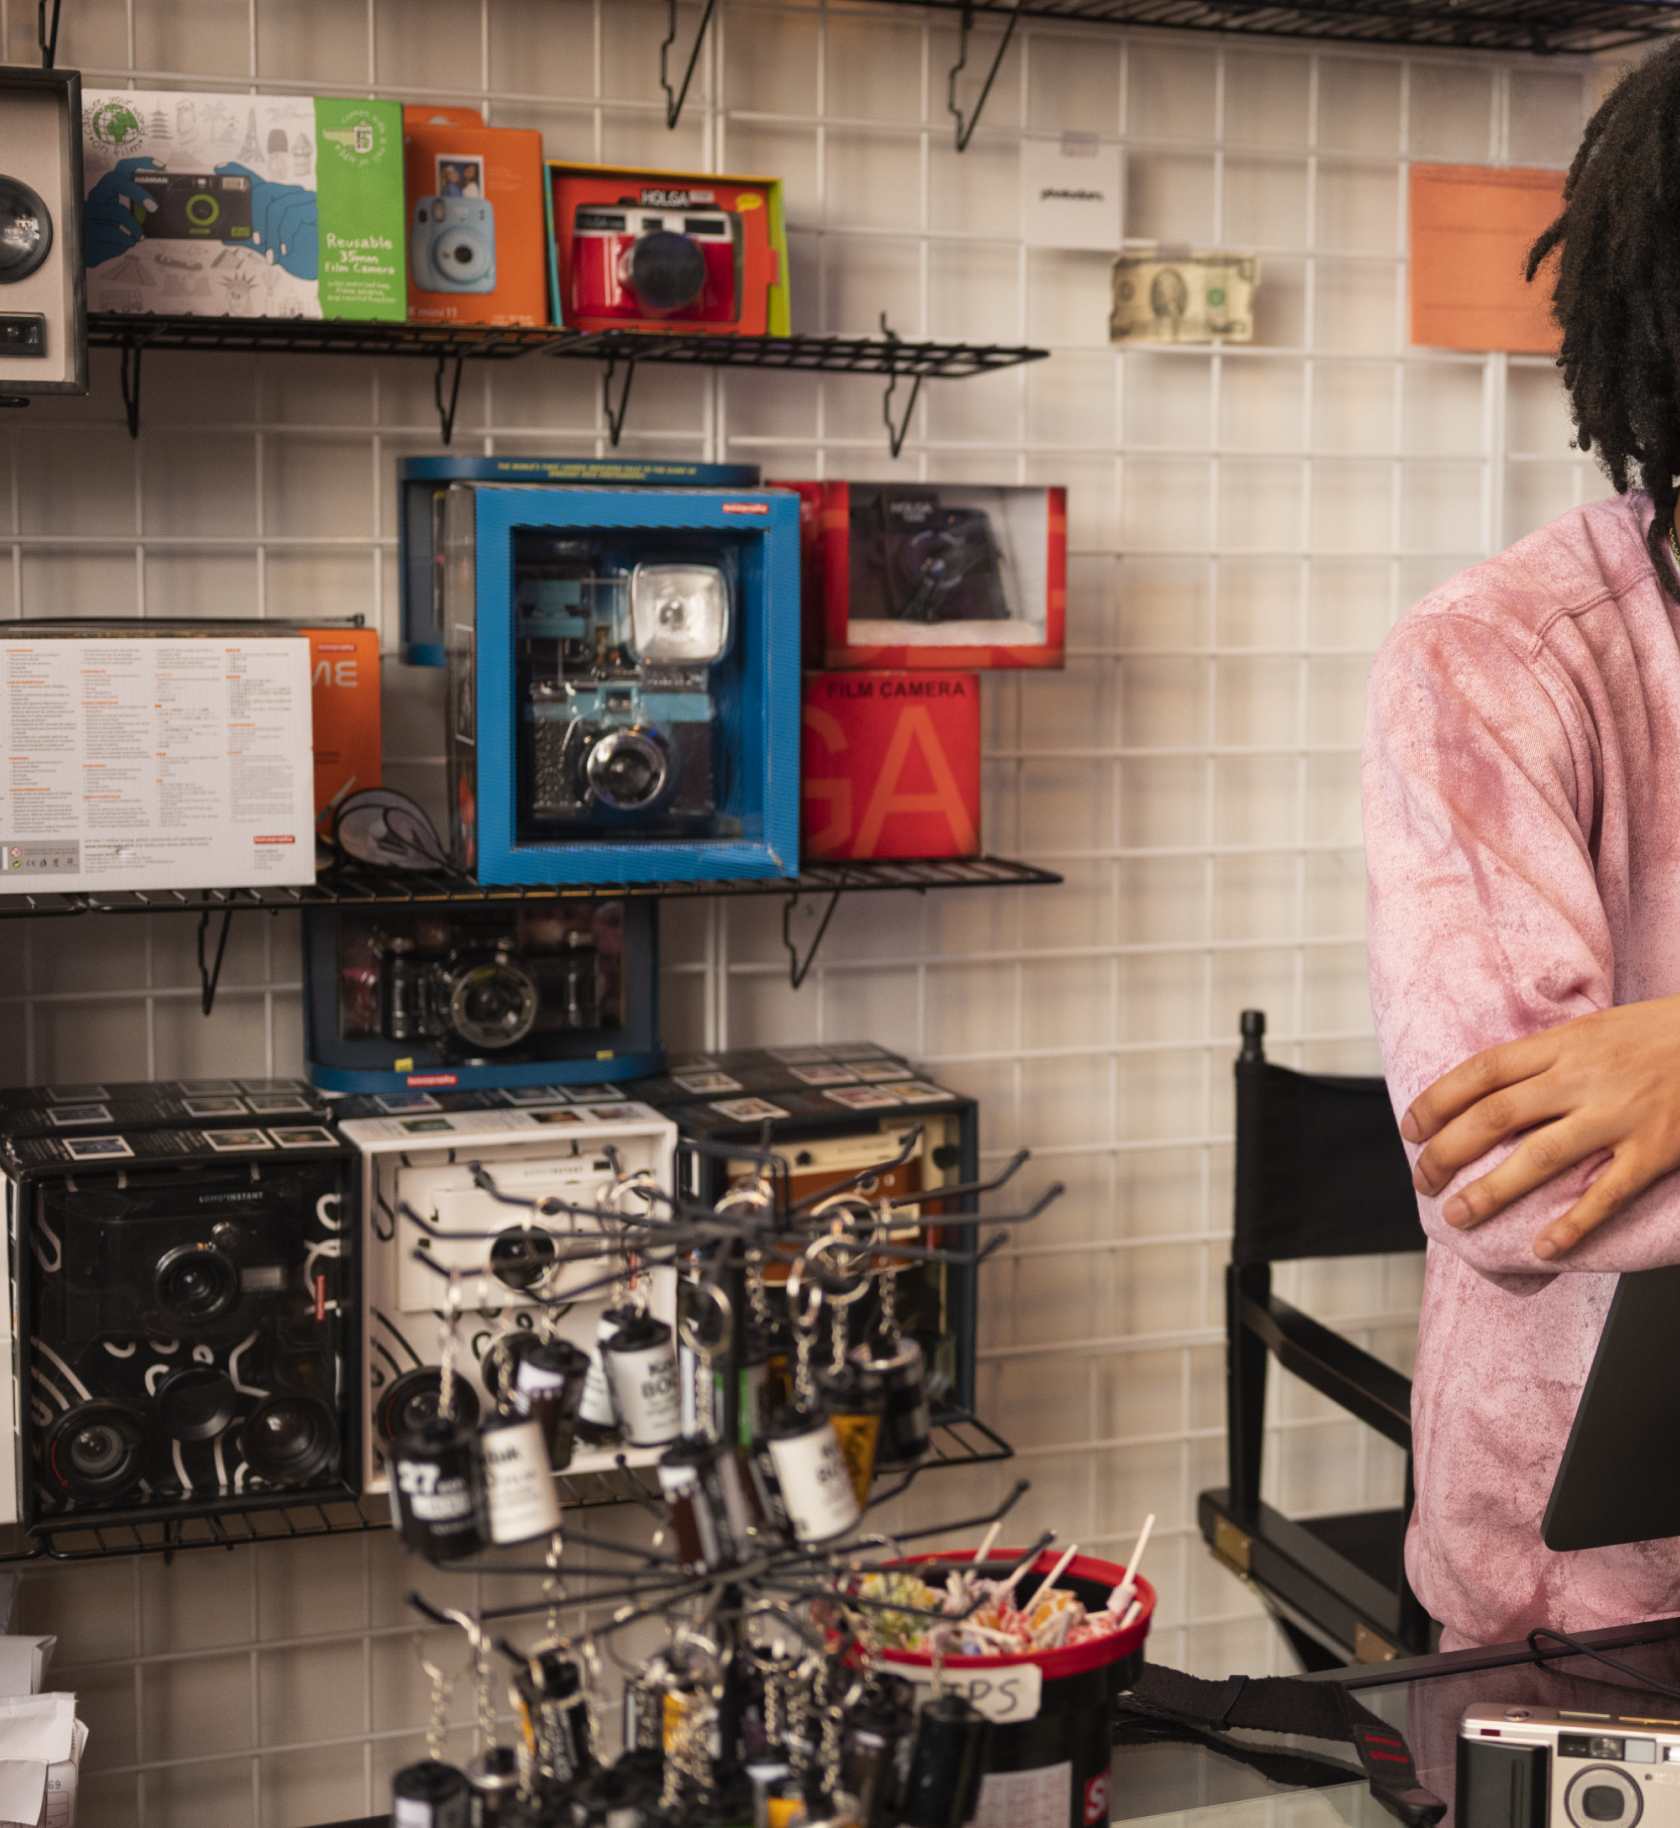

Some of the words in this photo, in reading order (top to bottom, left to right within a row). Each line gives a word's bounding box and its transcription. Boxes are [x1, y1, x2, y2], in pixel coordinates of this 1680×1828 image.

[641, 190, 690, 208] HOLGA
[326, 232, 393, 250] Reusable
[340, 249, 379, 264] 35mm
[324, 261, 349, 272] Film
[353, 262, 395, 276] Camera
[827, 682, 874, 699] FILM
[879, 680, 966, 699] CAMERA
[397, 1459, 440, 1496] 27
